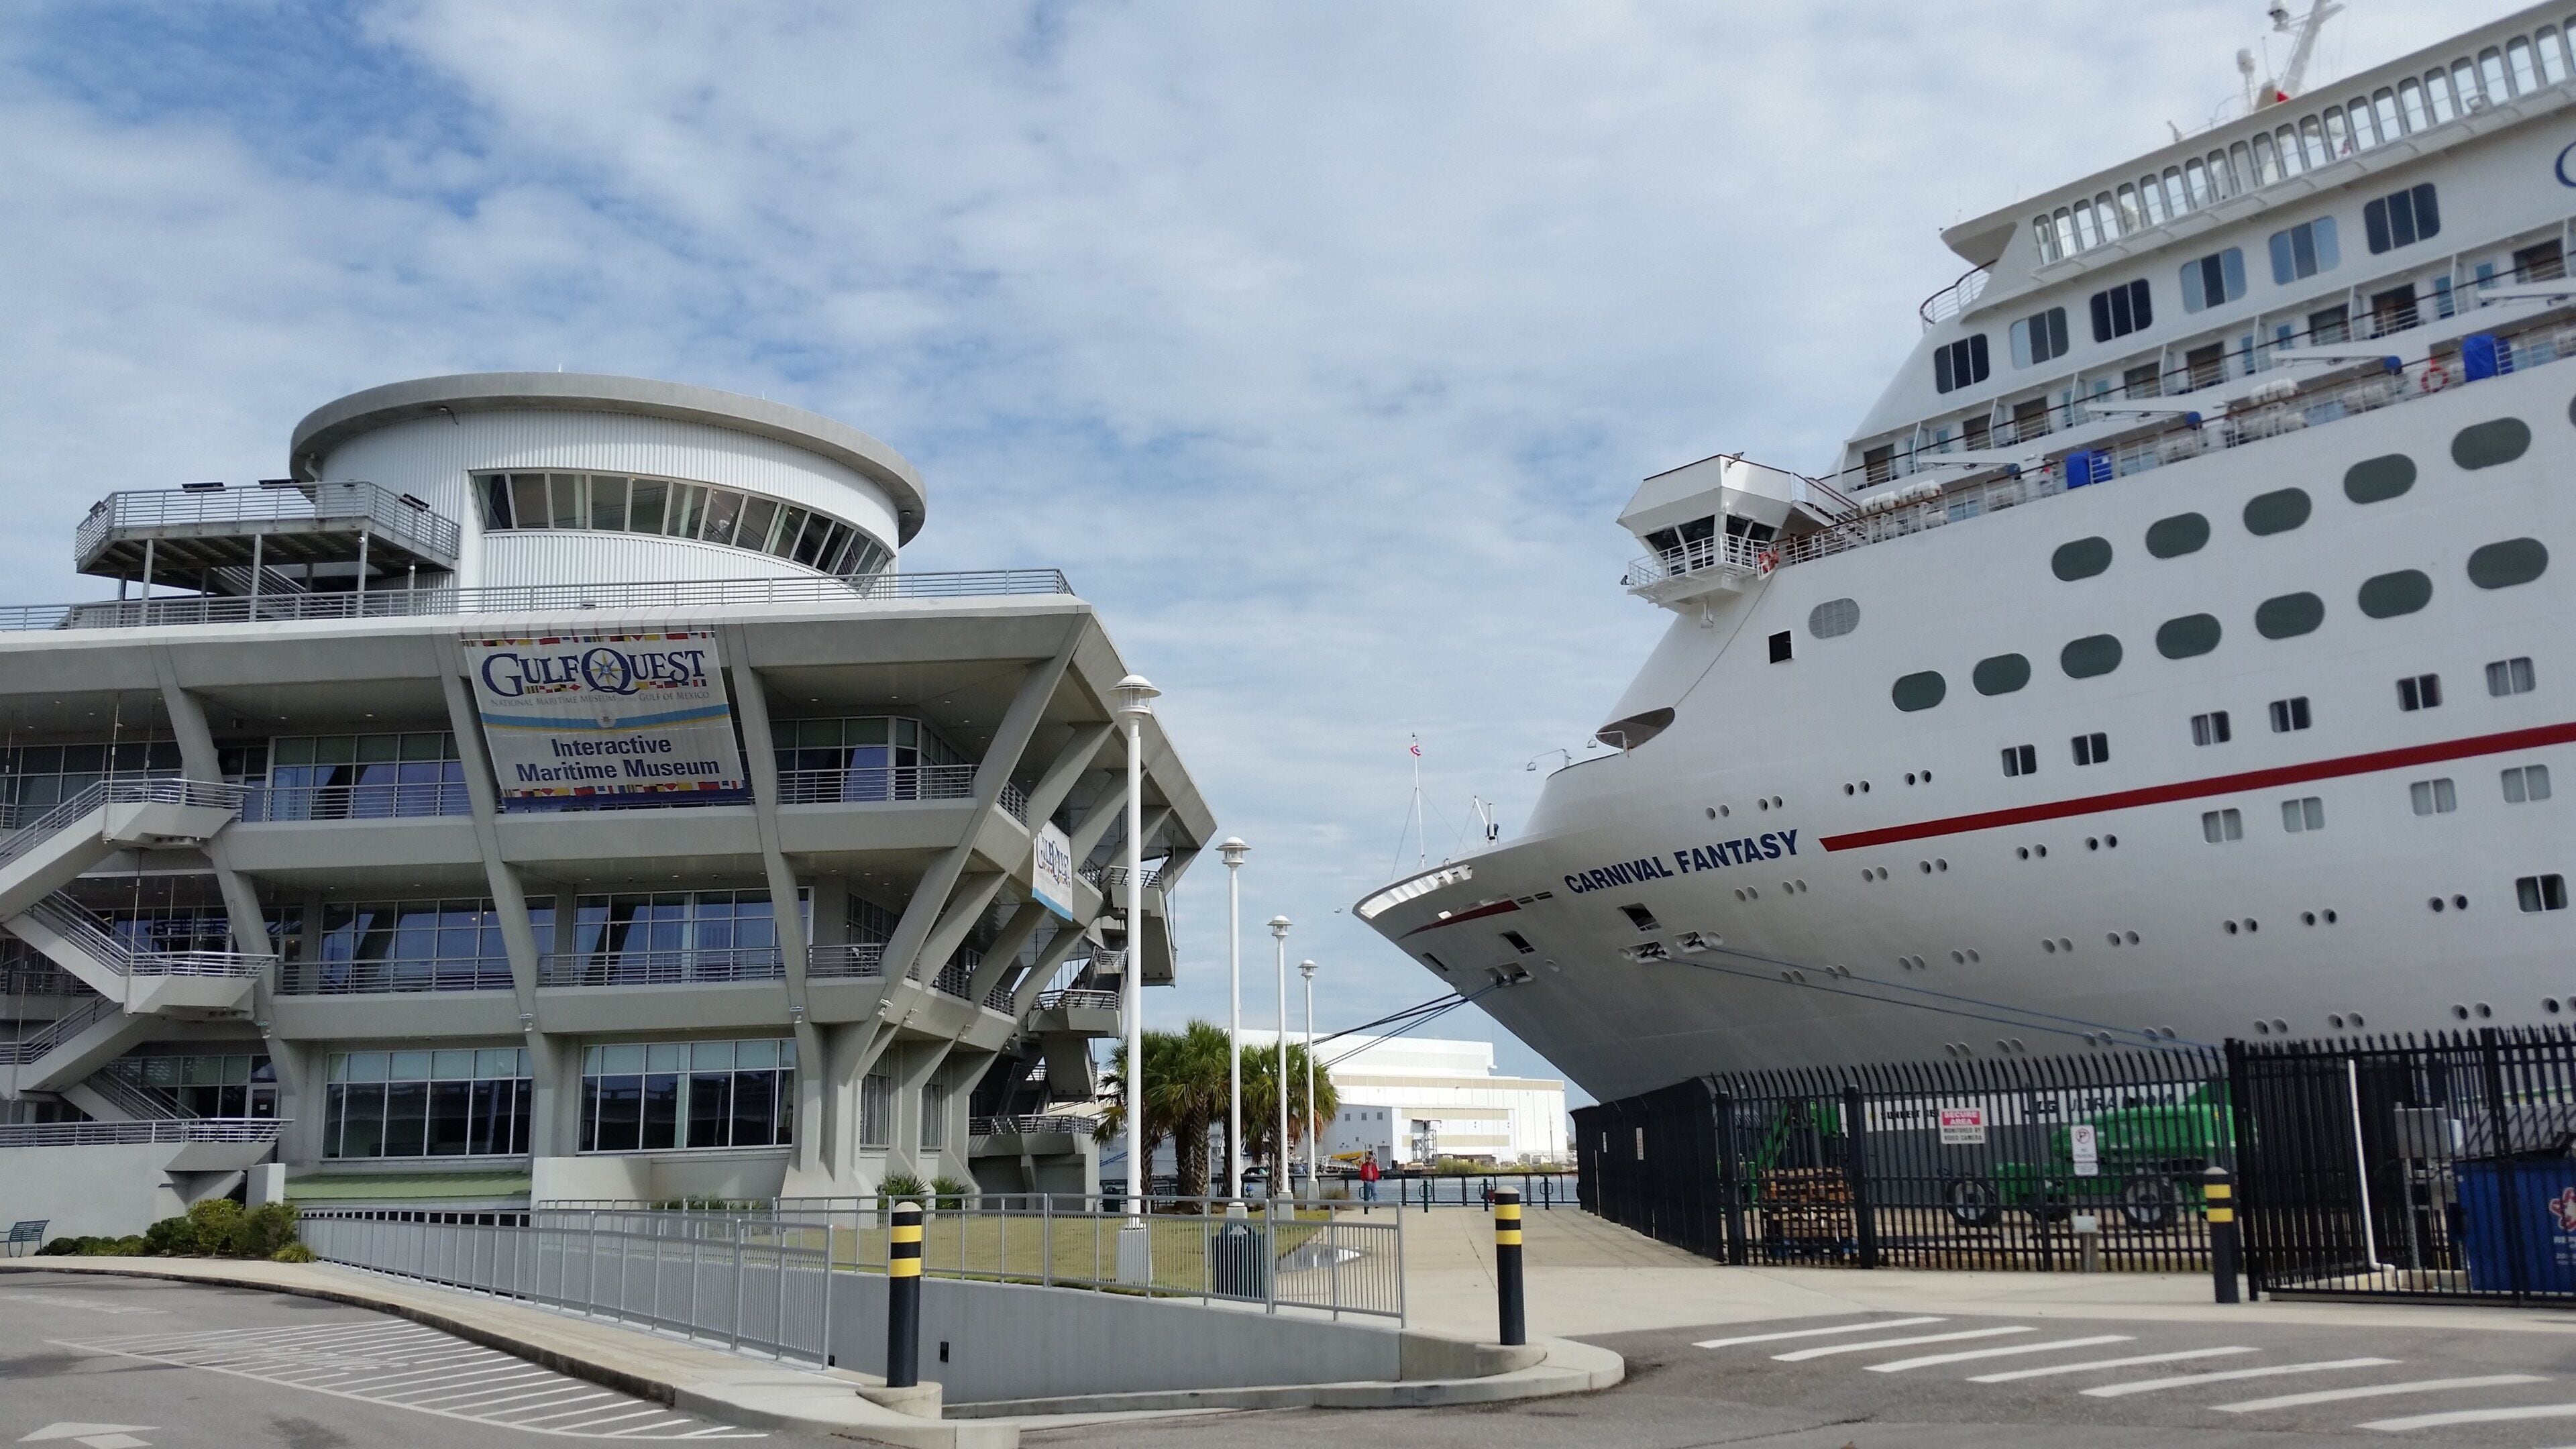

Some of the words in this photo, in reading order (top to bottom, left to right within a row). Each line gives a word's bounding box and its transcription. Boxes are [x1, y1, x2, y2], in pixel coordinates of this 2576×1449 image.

[537, 696, 577, 705] MARITIME
[580, 694, 616, 703] MUSEUM
[639, 693, 660, 702] GULF
[676, 691, 709, 700] MEXICO
[551, 735, 672, 757] Interactive
[516, 761, 617, 782] Maritime
[623, 759, 720, 777] Museum
[1564, 856, 1674, 894] CARNIVAL
[1674, 829, 1798, 873] FANTASY
